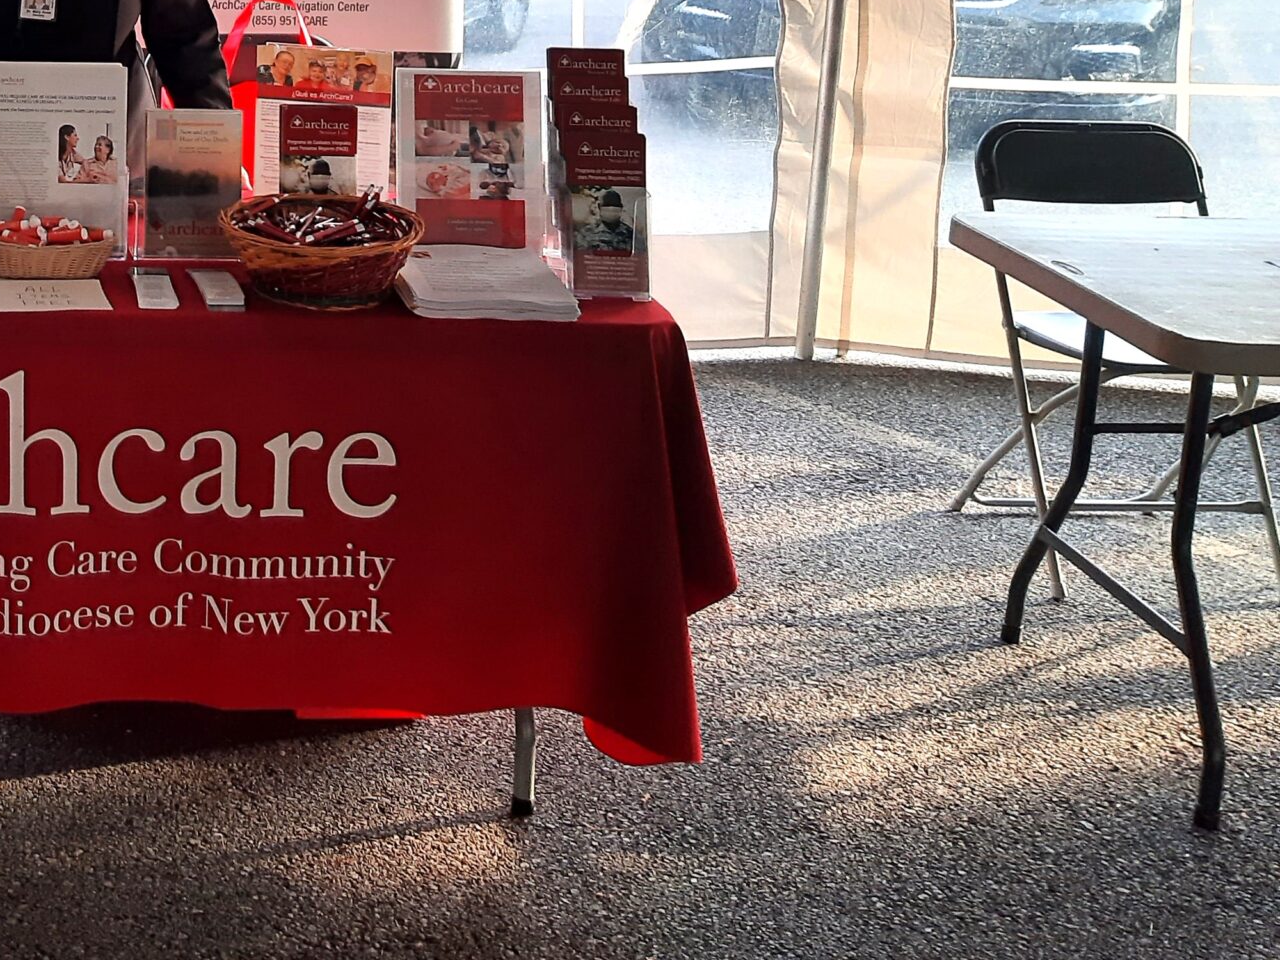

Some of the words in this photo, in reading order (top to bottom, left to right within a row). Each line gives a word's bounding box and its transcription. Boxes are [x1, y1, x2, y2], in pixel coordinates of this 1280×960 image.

[573, 59, 618, 70] archcare
[443, 78, 520, 95] archcare
[575, 84, 622, 97] archcare
[305, 118, 350, 130] archcare
[585, 115, 631, 127] archcare
[593, 145, 640, 158] archcare
[48, 541, 137, 577] Care
[154, 539, 394, 591] Community
[150, 592, 193, 627] of
[202, 595, 289, 634] New
[297, 598, 391, 633] York
